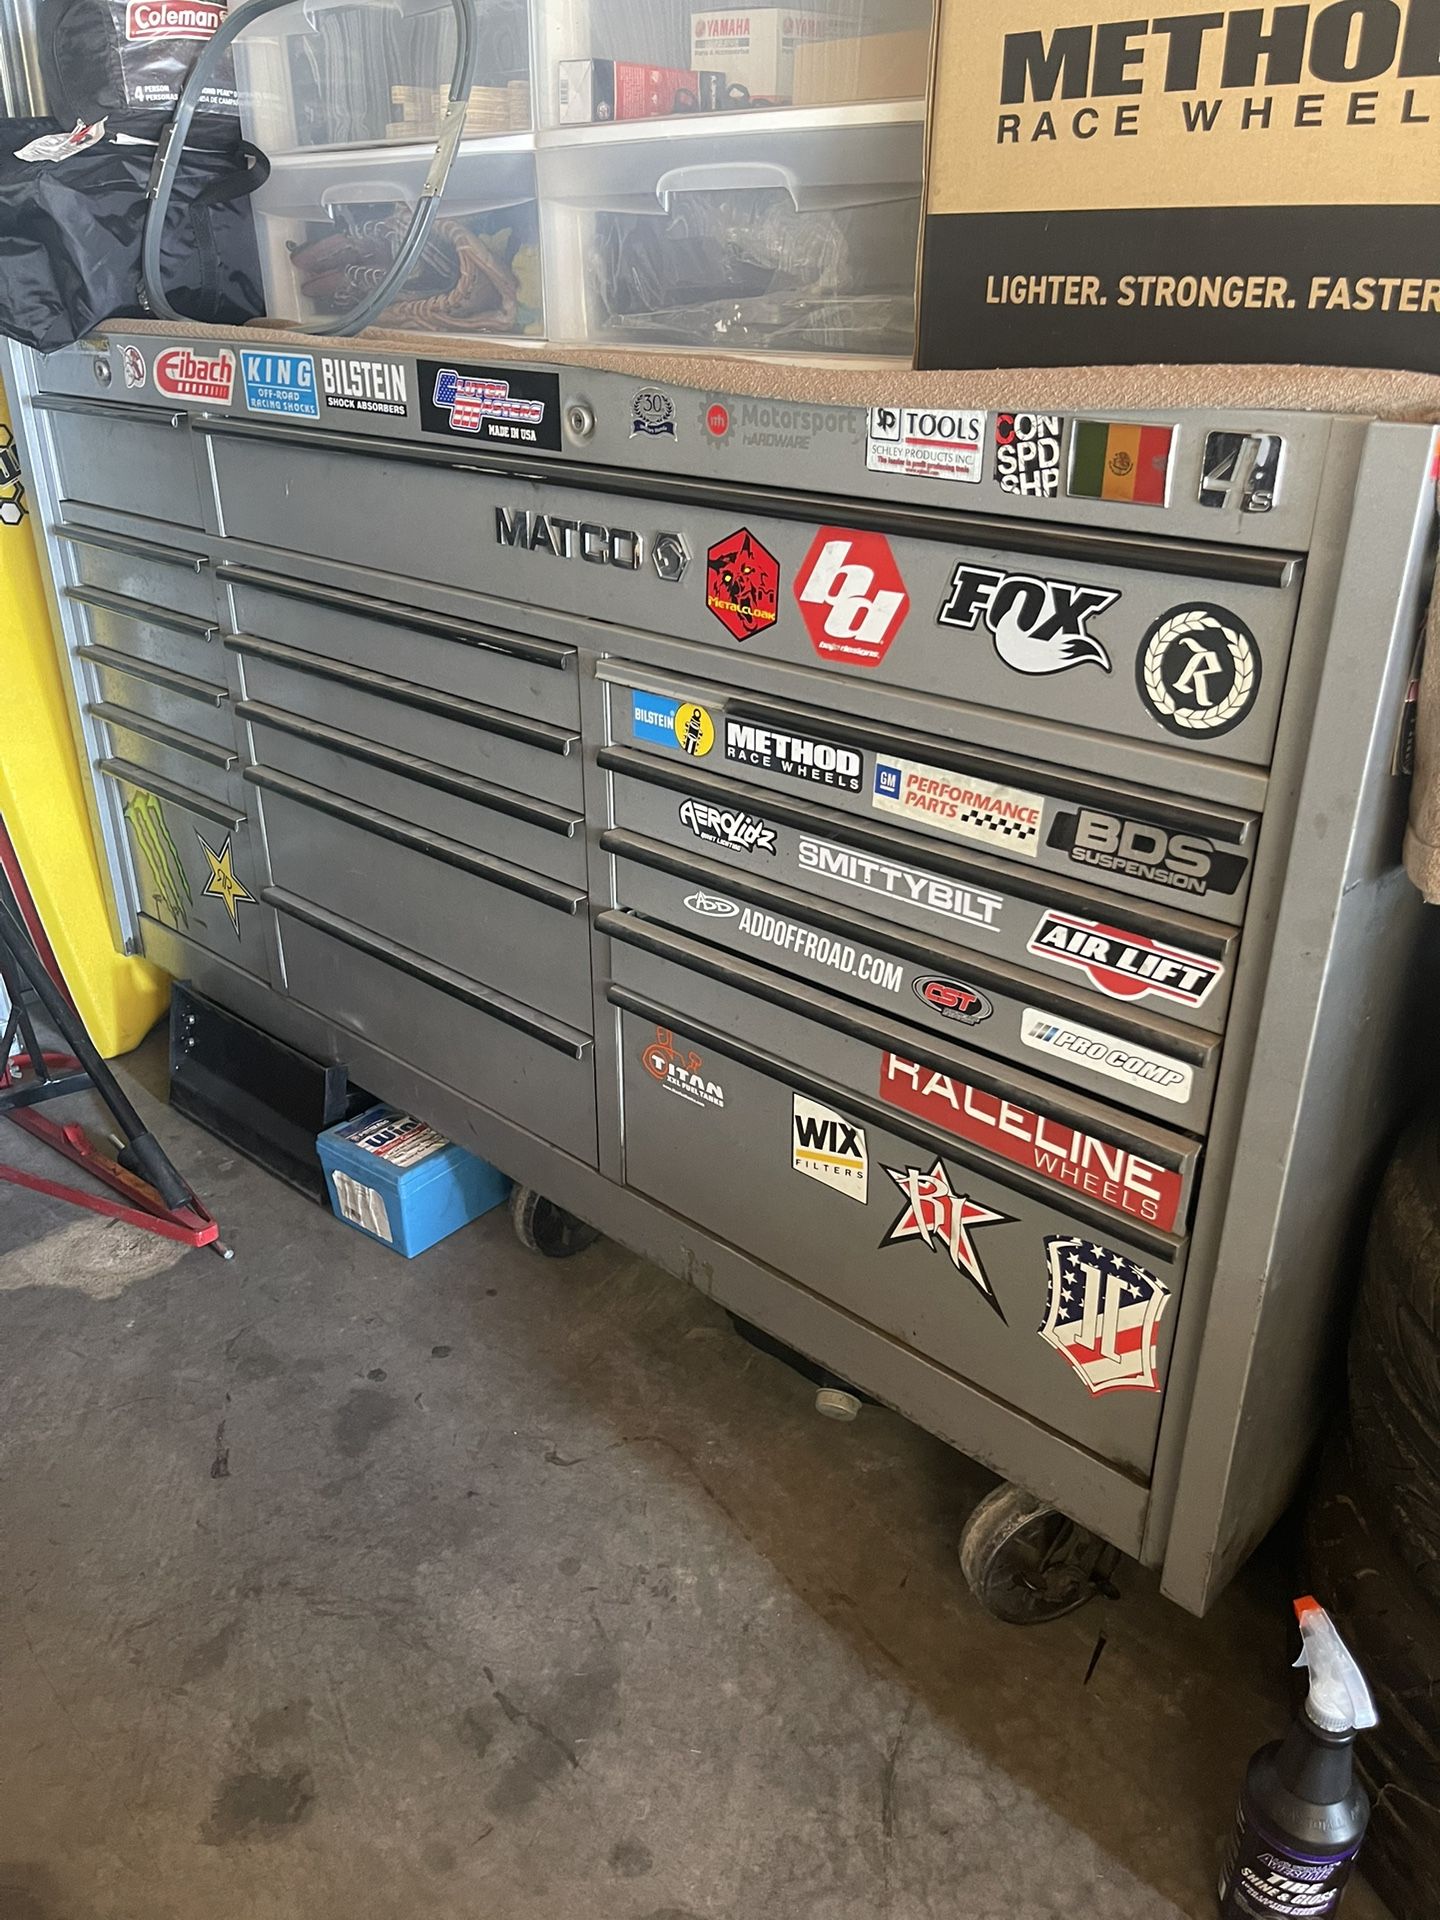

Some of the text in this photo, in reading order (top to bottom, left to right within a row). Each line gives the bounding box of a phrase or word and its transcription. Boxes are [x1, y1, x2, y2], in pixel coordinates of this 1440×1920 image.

[135, 5, 218, 29] Coleman
[707, 18, 750, 37] YAMAHA
[134, 85, 144, 102] 4
[145, 93, 178, 101] PERSONAS
[997, 89, 1430, 145] RACE WHEEL
[986, 275, 1440, 312] LIGHTER. STRONGER. FASTER
[156, 351, 231, 388] Eibach
[247, 356, 312, 387] KING
[321, 357, 407, 402] BILSTEIN
[250, 398, 315, 415] RACING SHOCKS
[257, 387, 300, 401] OFF-ROAD
[328, 396, 405, 415] SHOCK ABSORBERS
[643, 394, 662, 413] 30
[488, 424, 536, 441] MADE IN USA
[741, 404, 857, 436] Motorsport
[906, 413, 979, 441] TOOLS
[996, 413, 1060, 445] CON
[742, 433, 811, 450] HARDWARE
[872, 445, 903, 456] SCHLEY
[905, 448, 953, 463] PRODUCTS
[997, 437, 1060, 475] SPD
[495, 506, 644, 571] MATCO
[800, 540, 905, 644] bd
[938, 562, 1122, 643] FOX
[634, 707, 674, 731] BILSTEIN
[727, 722, 861, 777] METHOD
[727, 747, 859, 789] RACE WHEELS
[880, 771, 1040, 825] GM PERFORMANCE
[904, 791, 959, 818] PARTS
[1075, 809, 1214, 878] BDS
[798, 841, 1002, 924] SMITTYBILT
[1071, 847, 1207, 894] SUSPENSION
[738, 907, 904, 993] ADDOFFROAD.COM
[1040, 925, 1208, 990] AIR LIFT
[924, 982, 977, 1012] CST
[651, 1054, 724, 1100] TITAN
[1053, 1030, 1185, 1088] PRO COMP
[667, 1075, 681, 1088] XXL
[682, 1082, 699, 1096] FUEL
[699, 1090, 724, 1107] TANKS
[795, 1115, 863, 1158] WIX
[886, 1053, 1166, 1202] RACELINE
[795, 1158, 863, 1179] FILTERS
[1033, 1148, 1159, 1222] WHEELS
[1240, 1866, 1280, 1897] SHINE
[1277, 1892, 1291, 1902] &
[1290, 1887, 1338, 1906] GLOSS
[1266, 1871, 1324, 1895] TIRE
